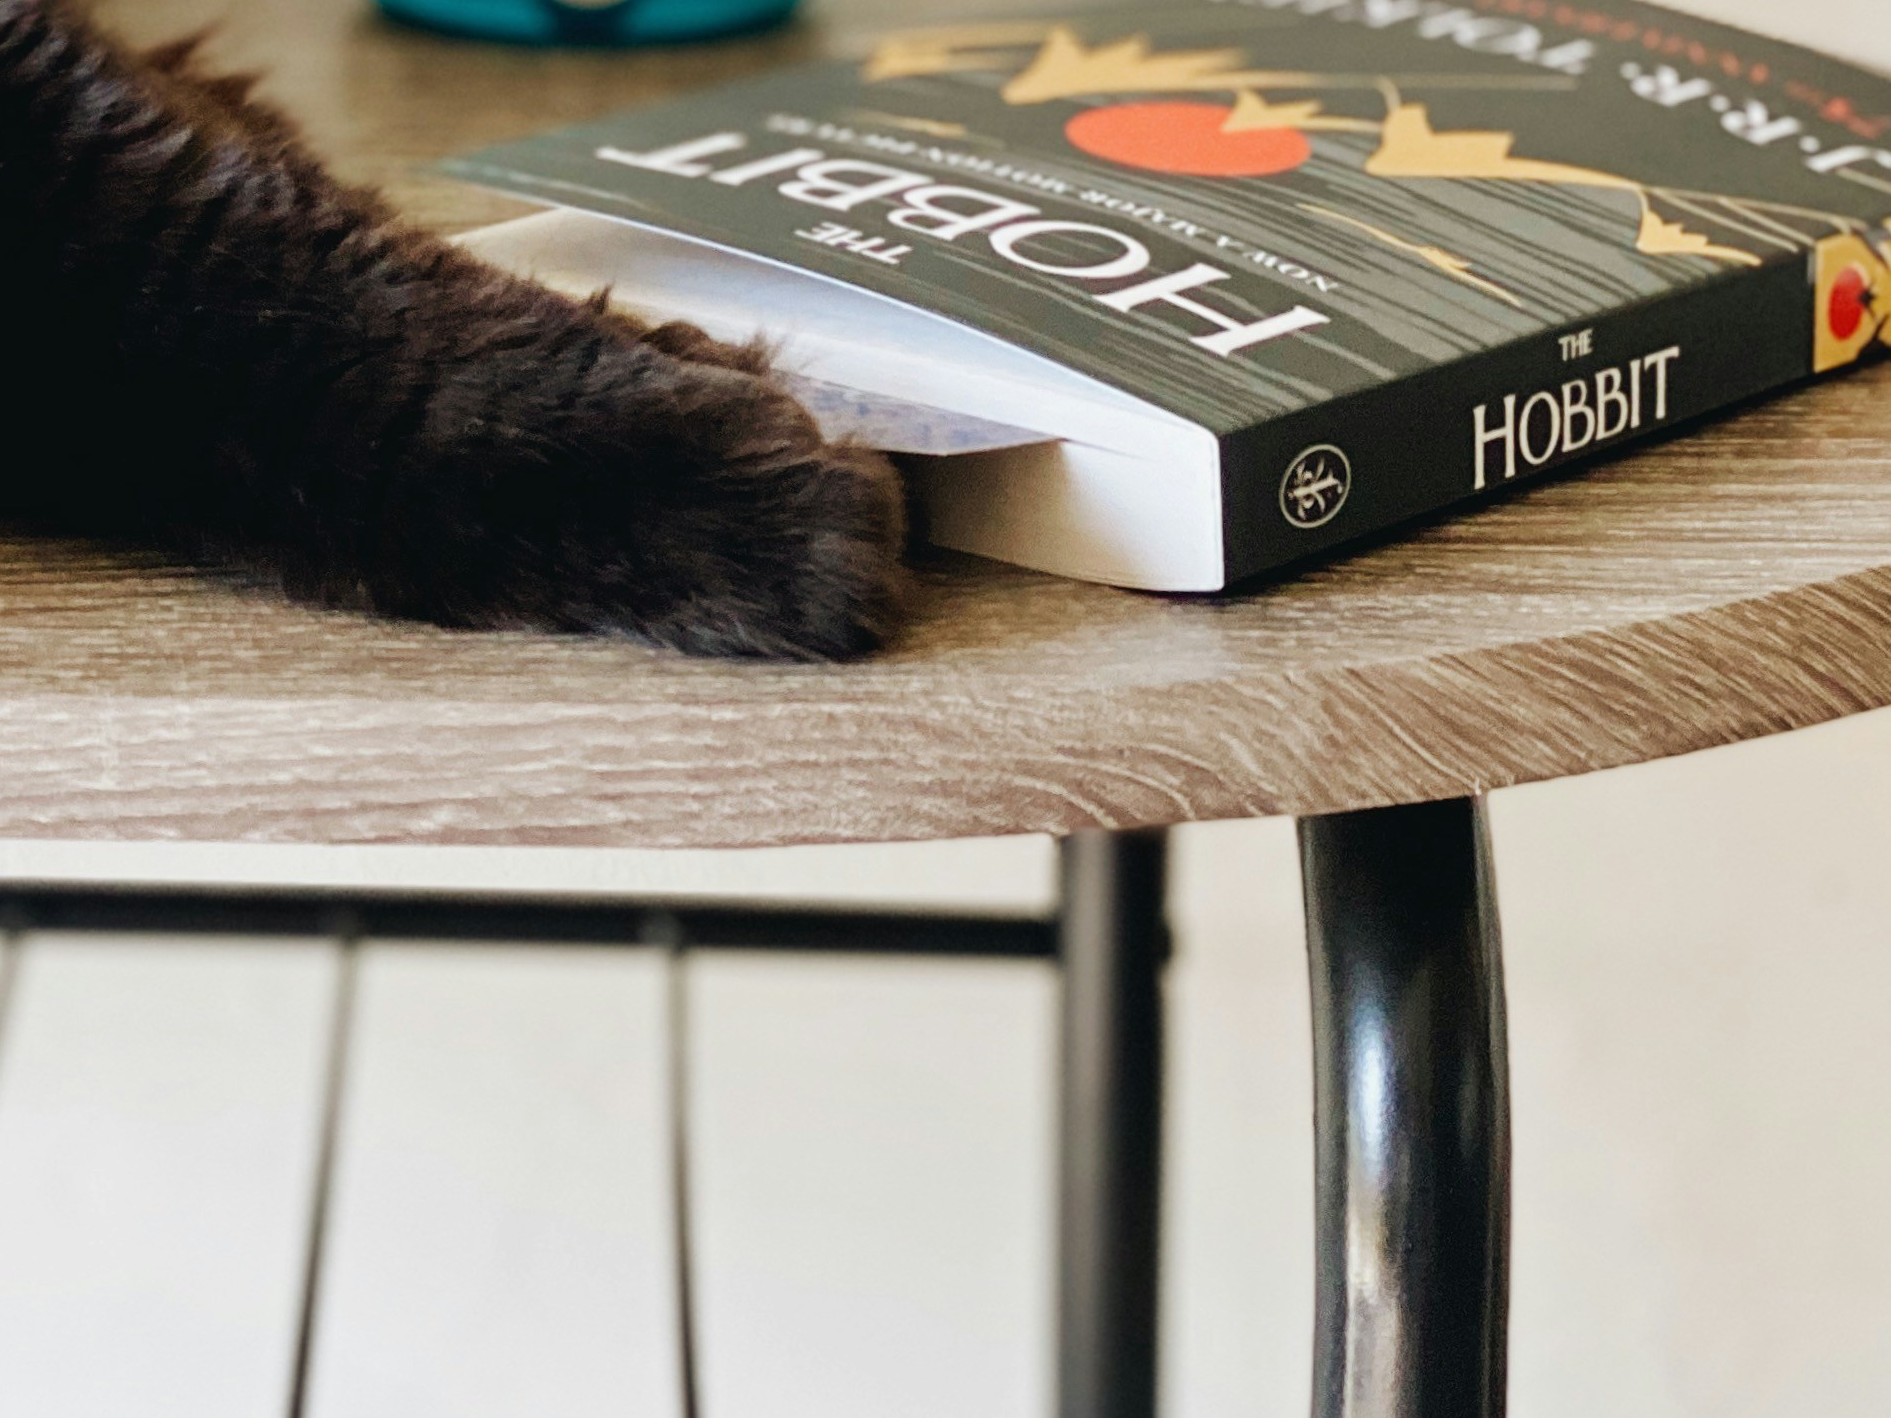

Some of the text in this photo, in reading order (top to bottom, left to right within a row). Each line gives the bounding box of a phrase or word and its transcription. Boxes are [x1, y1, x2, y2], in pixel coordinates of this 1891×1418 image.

[1079, 189, 1209, 237] MAJOR
[595, 131, 1332, 359] HOBBIT
[793, 220, 914, 265] THE
[1242, 250, 1339, 293] NOW
[1557, 328, 1594, 362] THE
[1472, 345, 1681, 490] HOBBIT
